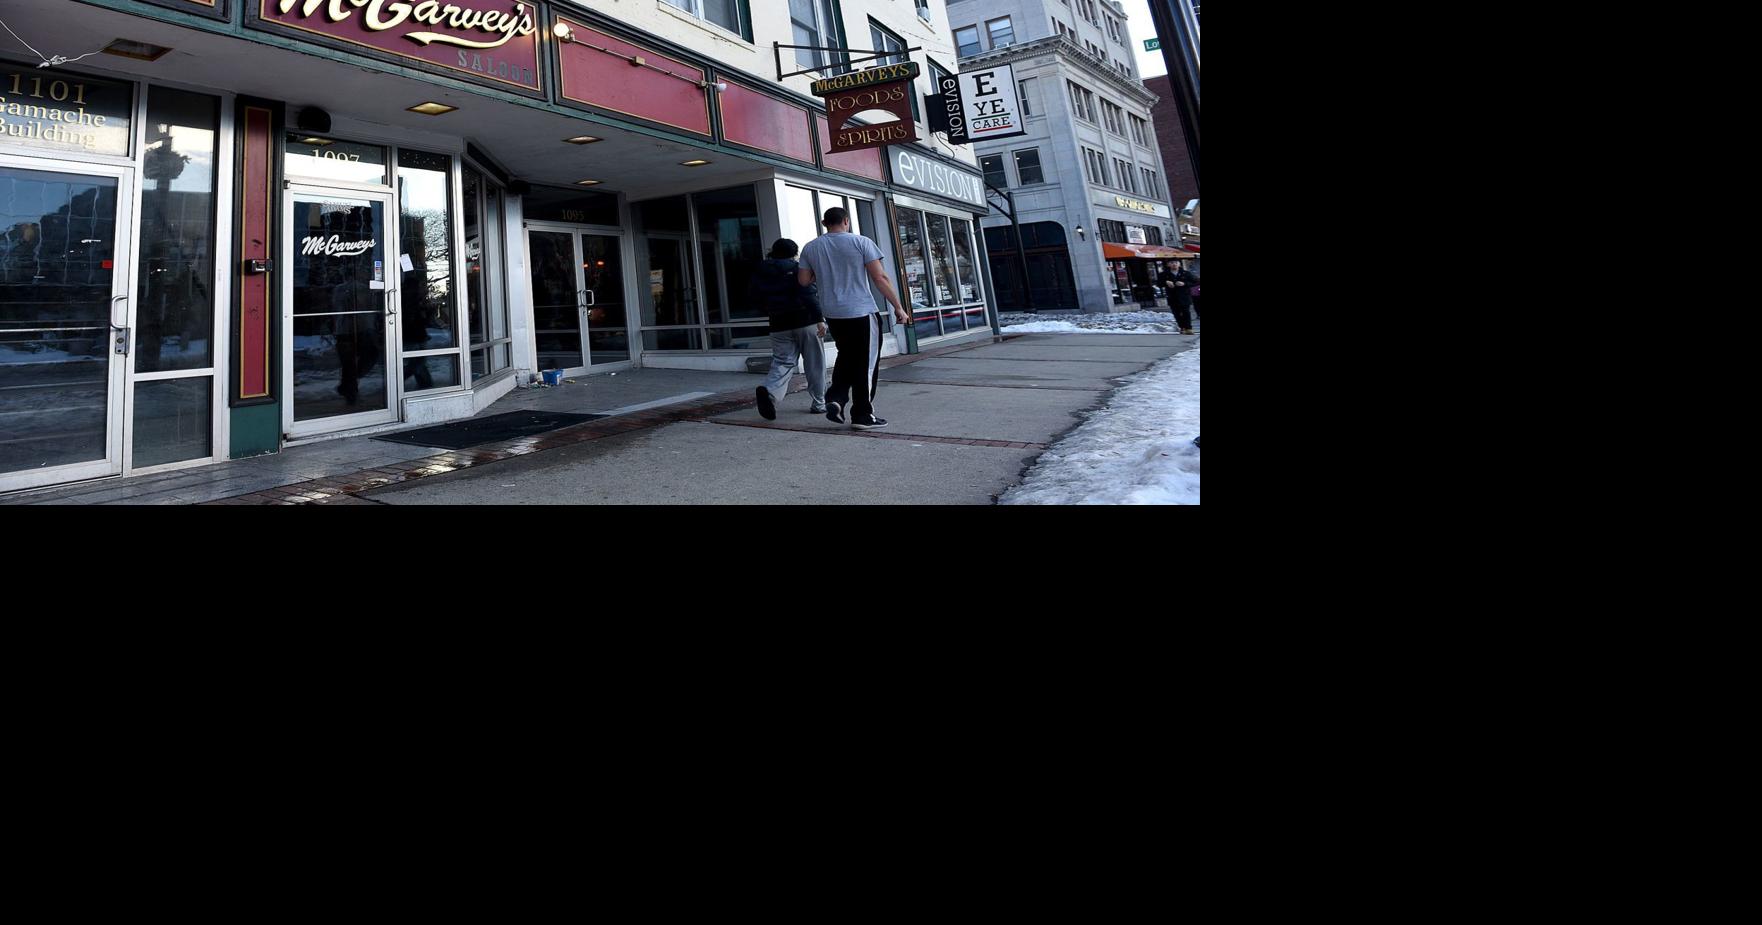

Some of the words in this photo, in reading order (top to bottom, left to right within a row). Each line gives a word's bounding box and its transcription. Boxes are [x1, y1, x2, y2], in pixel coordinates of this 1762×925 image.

[8, 74, 87, 105] 1101
[815, 64, 910, 92] McGARVEYS
[972, 72, 998, 97] E
[830, 86, 905, 112] FOODS
[973, 99, 1006, 116] YE
[0, 97, 106, 127] amache
[972, 116, 1010, 129] CARE
[837, 124, 907, 146] SPIRITS
[302, 234, 377, 257] McGarveys
